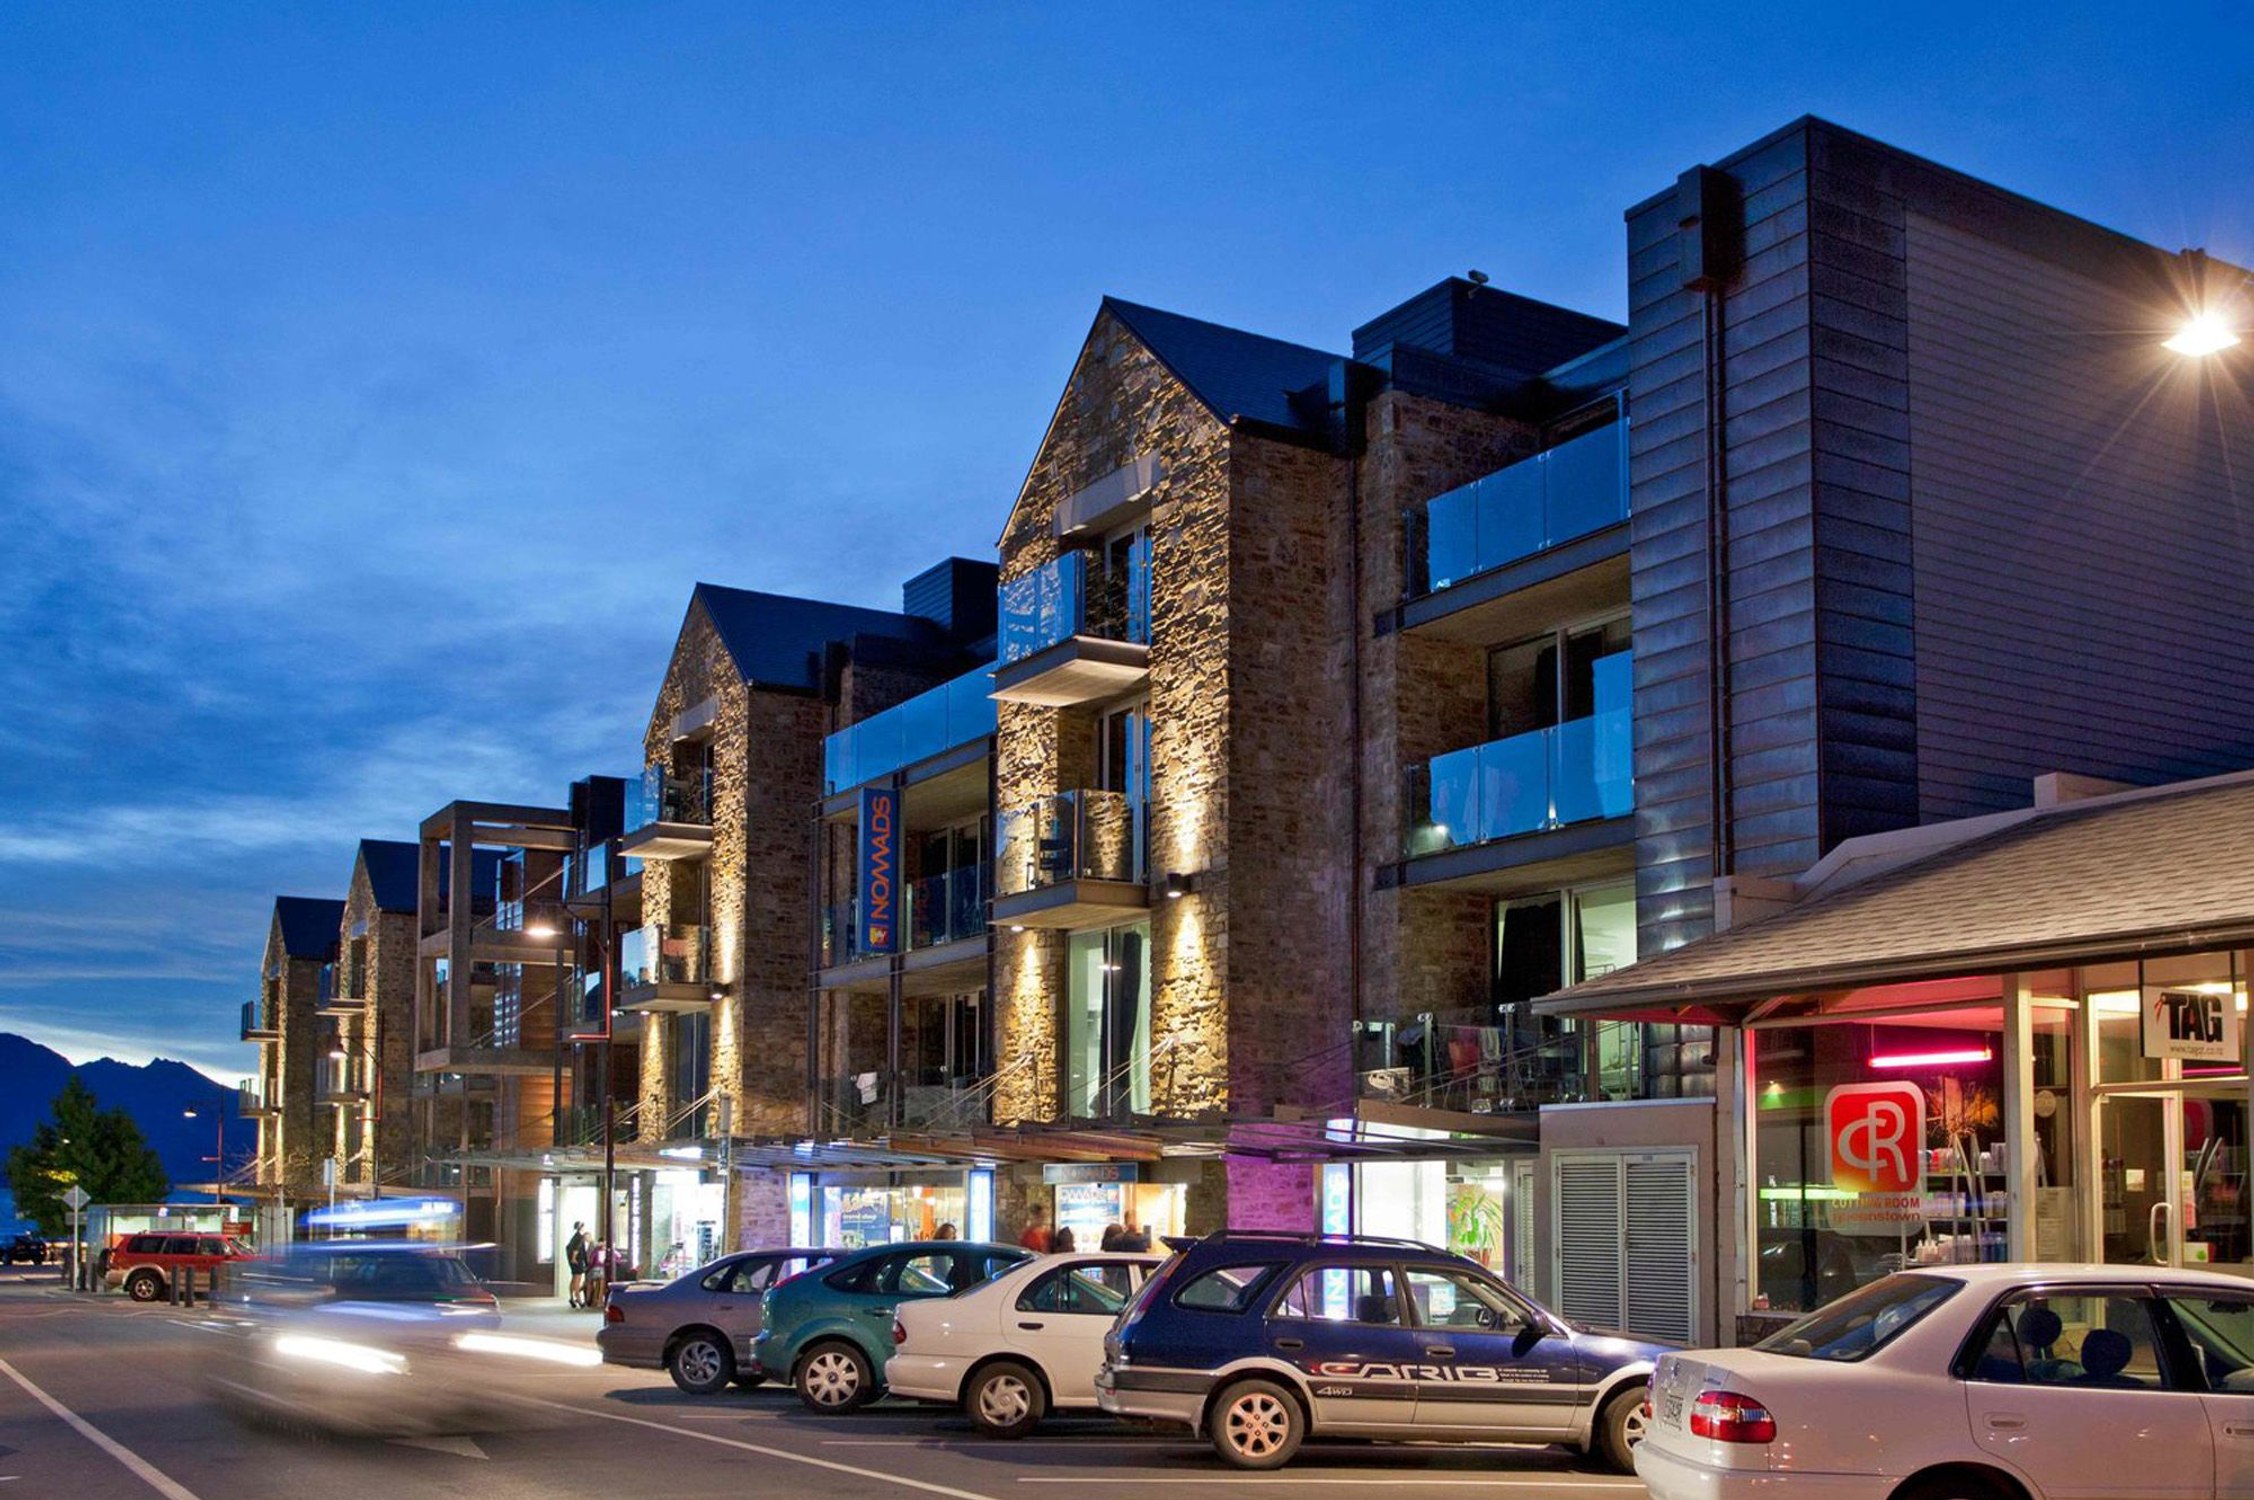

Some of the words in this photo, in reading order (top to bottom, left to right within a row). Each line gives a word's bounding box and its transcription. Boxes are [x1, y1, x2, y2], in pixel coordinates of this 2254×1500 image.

[871, 796, 890, 918] NOMADS
[2161, 992, 2223, 1042] TAG
[1885, 1198, 1920, 1208] ROOM
[1833, 1211, 1920, 1224] queenstown
[1320, 1362, 1499, 1382] CARIB
[1317, 1385, 1352, 1396] 4WD
